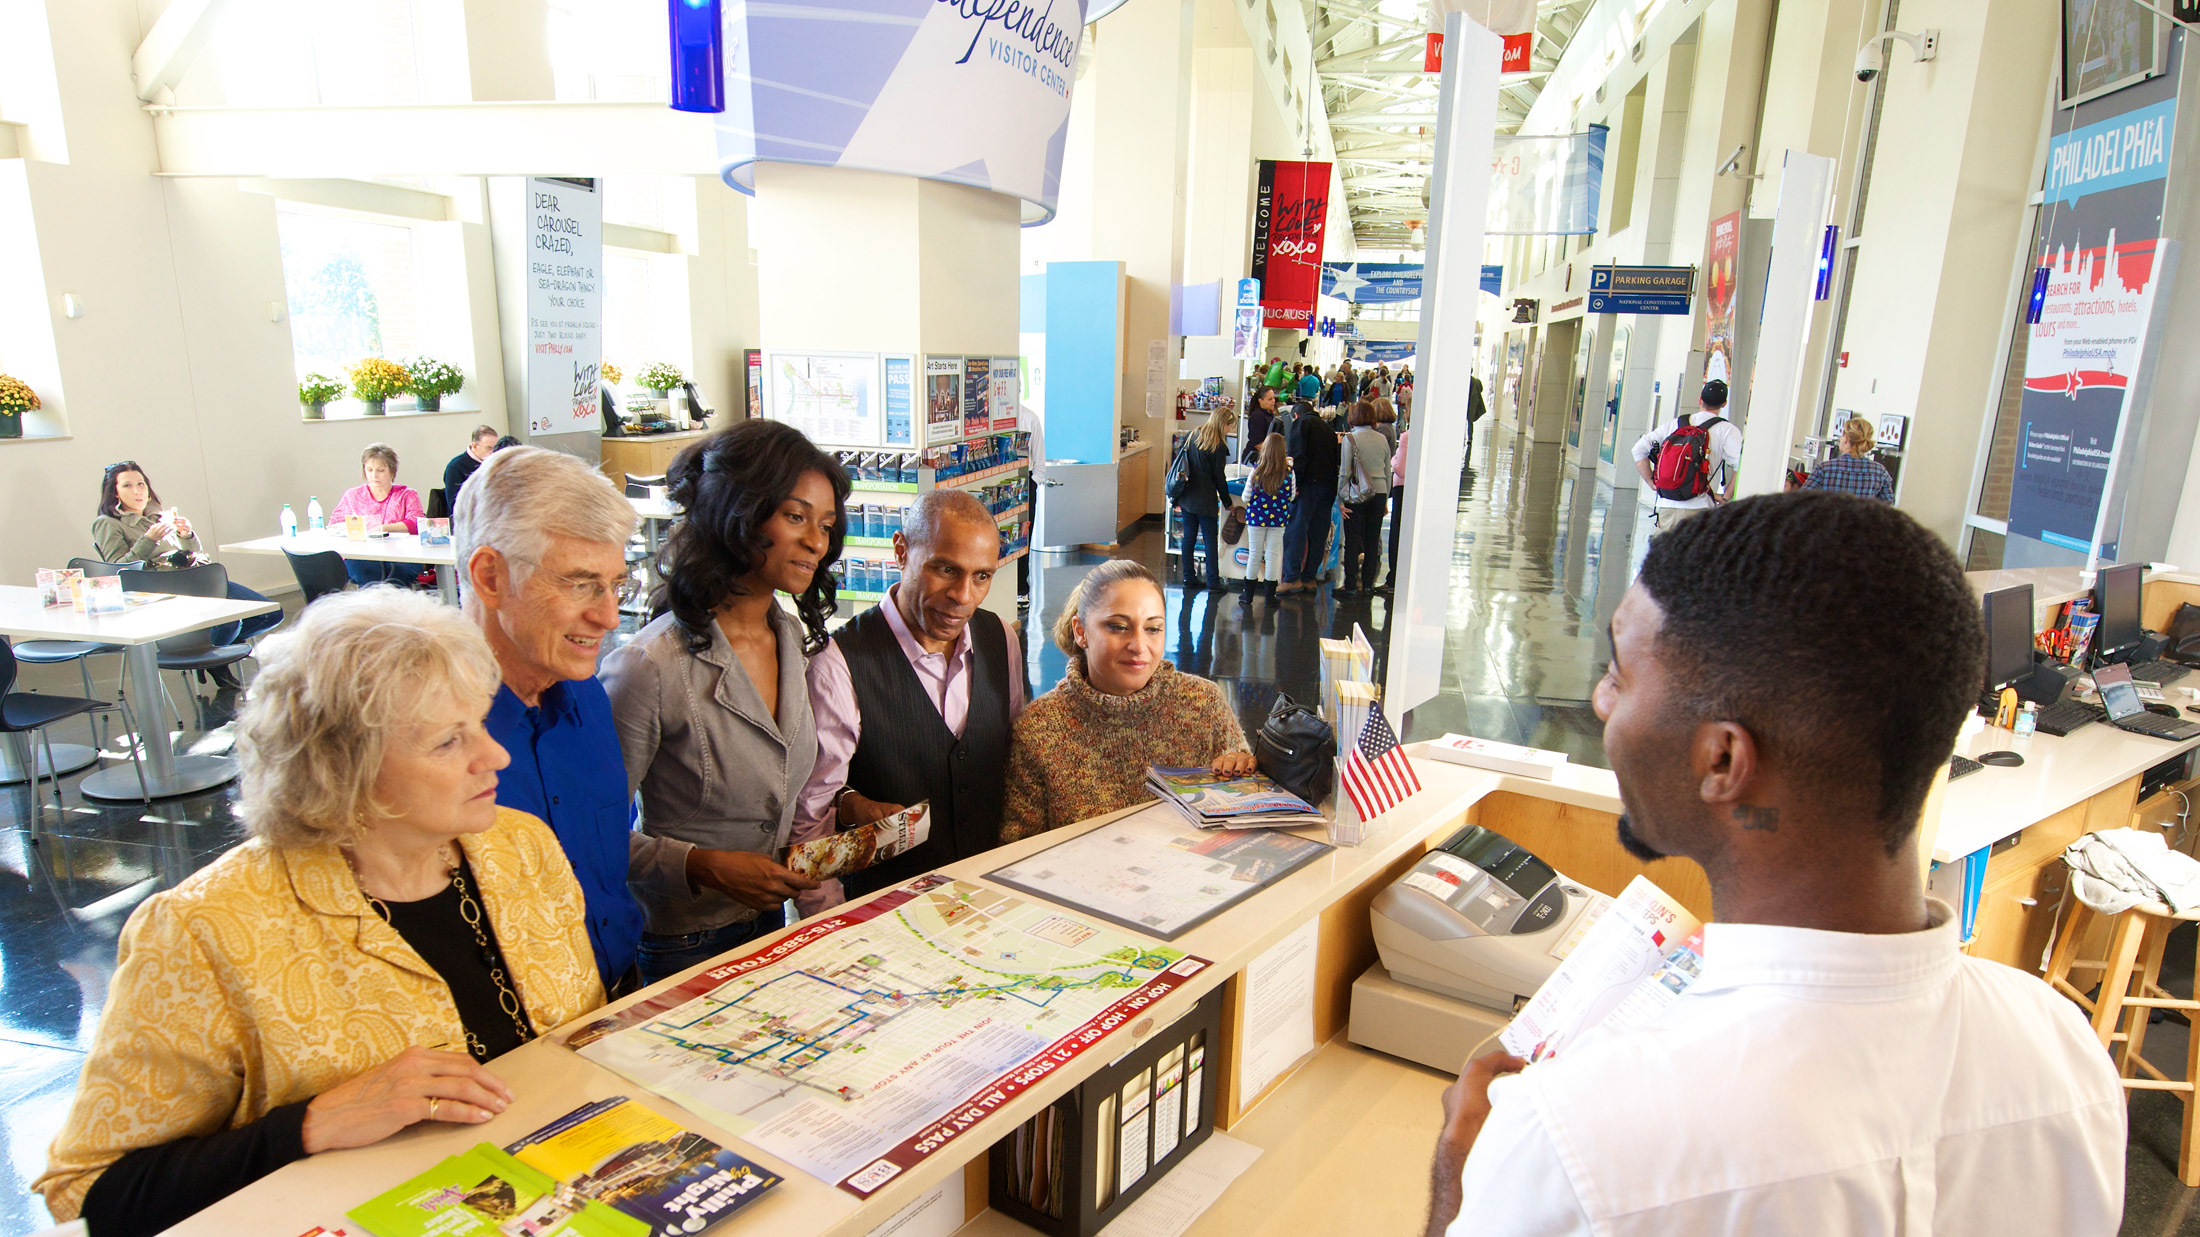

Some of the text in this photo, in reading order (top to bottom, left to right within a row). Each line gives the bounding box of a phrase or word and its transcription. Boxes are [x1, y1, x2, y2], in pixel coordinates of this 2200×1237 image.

[938, 0, 1073, 67] ependence
[989, 37, 1066, 98] VISITOR CENTER
[535, 192, 560, 212] DEAR
[1277, 193, 1327, 219] WITH
[537, 214, 582, 237] CAROUSEL
[1255, 185, 1271, 266] WELCOME
[1275, 216, 1315, 233] LOVE
[535, 234, 574, 256] CRAZED,
[533, 262, 554, 276] EAGLE,
[557, 266, 584, 278] ELEPHANT
[1392, 271, 1424, 280] PHILADELPH
[1392, 279, 1404, 287] AND
[1594, 272, 1607, 287] P
[1615, 276, 1686, 286] PARKING GARAGE
[1375, 286, 1419, 295] THE COUNTRYSIDE
[2046, 281, 2081, 297] SEARCH FOR
[548, 295, 565, 308] YOUR
[2073, 297, 2116, 316] attractions,
[2118, 300, 2138, 313] hotels,
[1263, 308, 1312, 320] DUCAUSE
[2109, 338, 2122, 346] phone
[573, 360, 599, 383] WITH
[934, 361, 947, 370] Starts
[948, 361, 958, 370] Here
[888, 374, 910, 384] PASS
[573, 380, 595, 398] LOVE
[853, 482, 899, 491] TRANSPORTATION
[854, 537, 894, 546] TRANSPORTATI
[1627, 896, 1660, 925] FOOTTEPS
[1634, 887, 1677, 923] FRAKLIN'S
[709, 918, 845, 979] 215-389-TOUR
[1147, 982, 1172, 999] HOP
[1127, 996, 1149, 1009] ON
[973, 1016, 992, 1029] JOIN
[1100, 1011, 1126, 1029] HOP
[955, 1028, 974, 1039] THE
[1078, 1028, 1101, 1043] OFF
[931, 1038, 957, 1053] TOUR
[919, 1051, 931, 1061] AT
[1051, 1048, 1071, 1060] 21
[898, 1059, 918, 1074] ANY
[1013, 1060, 1054, 1084] STOPS
[978, 1089, 1005, 1107] ALL
[951, 1107, 983, 1129] DAY
[913, 1126, 954, 1153] PASS
[729, 1164, 750, 1180] by
[857, 1163, 890, 1184] BUS
[662, 1168, 732, 1213] Night
[684, 1173, 763, 1220] Philly
